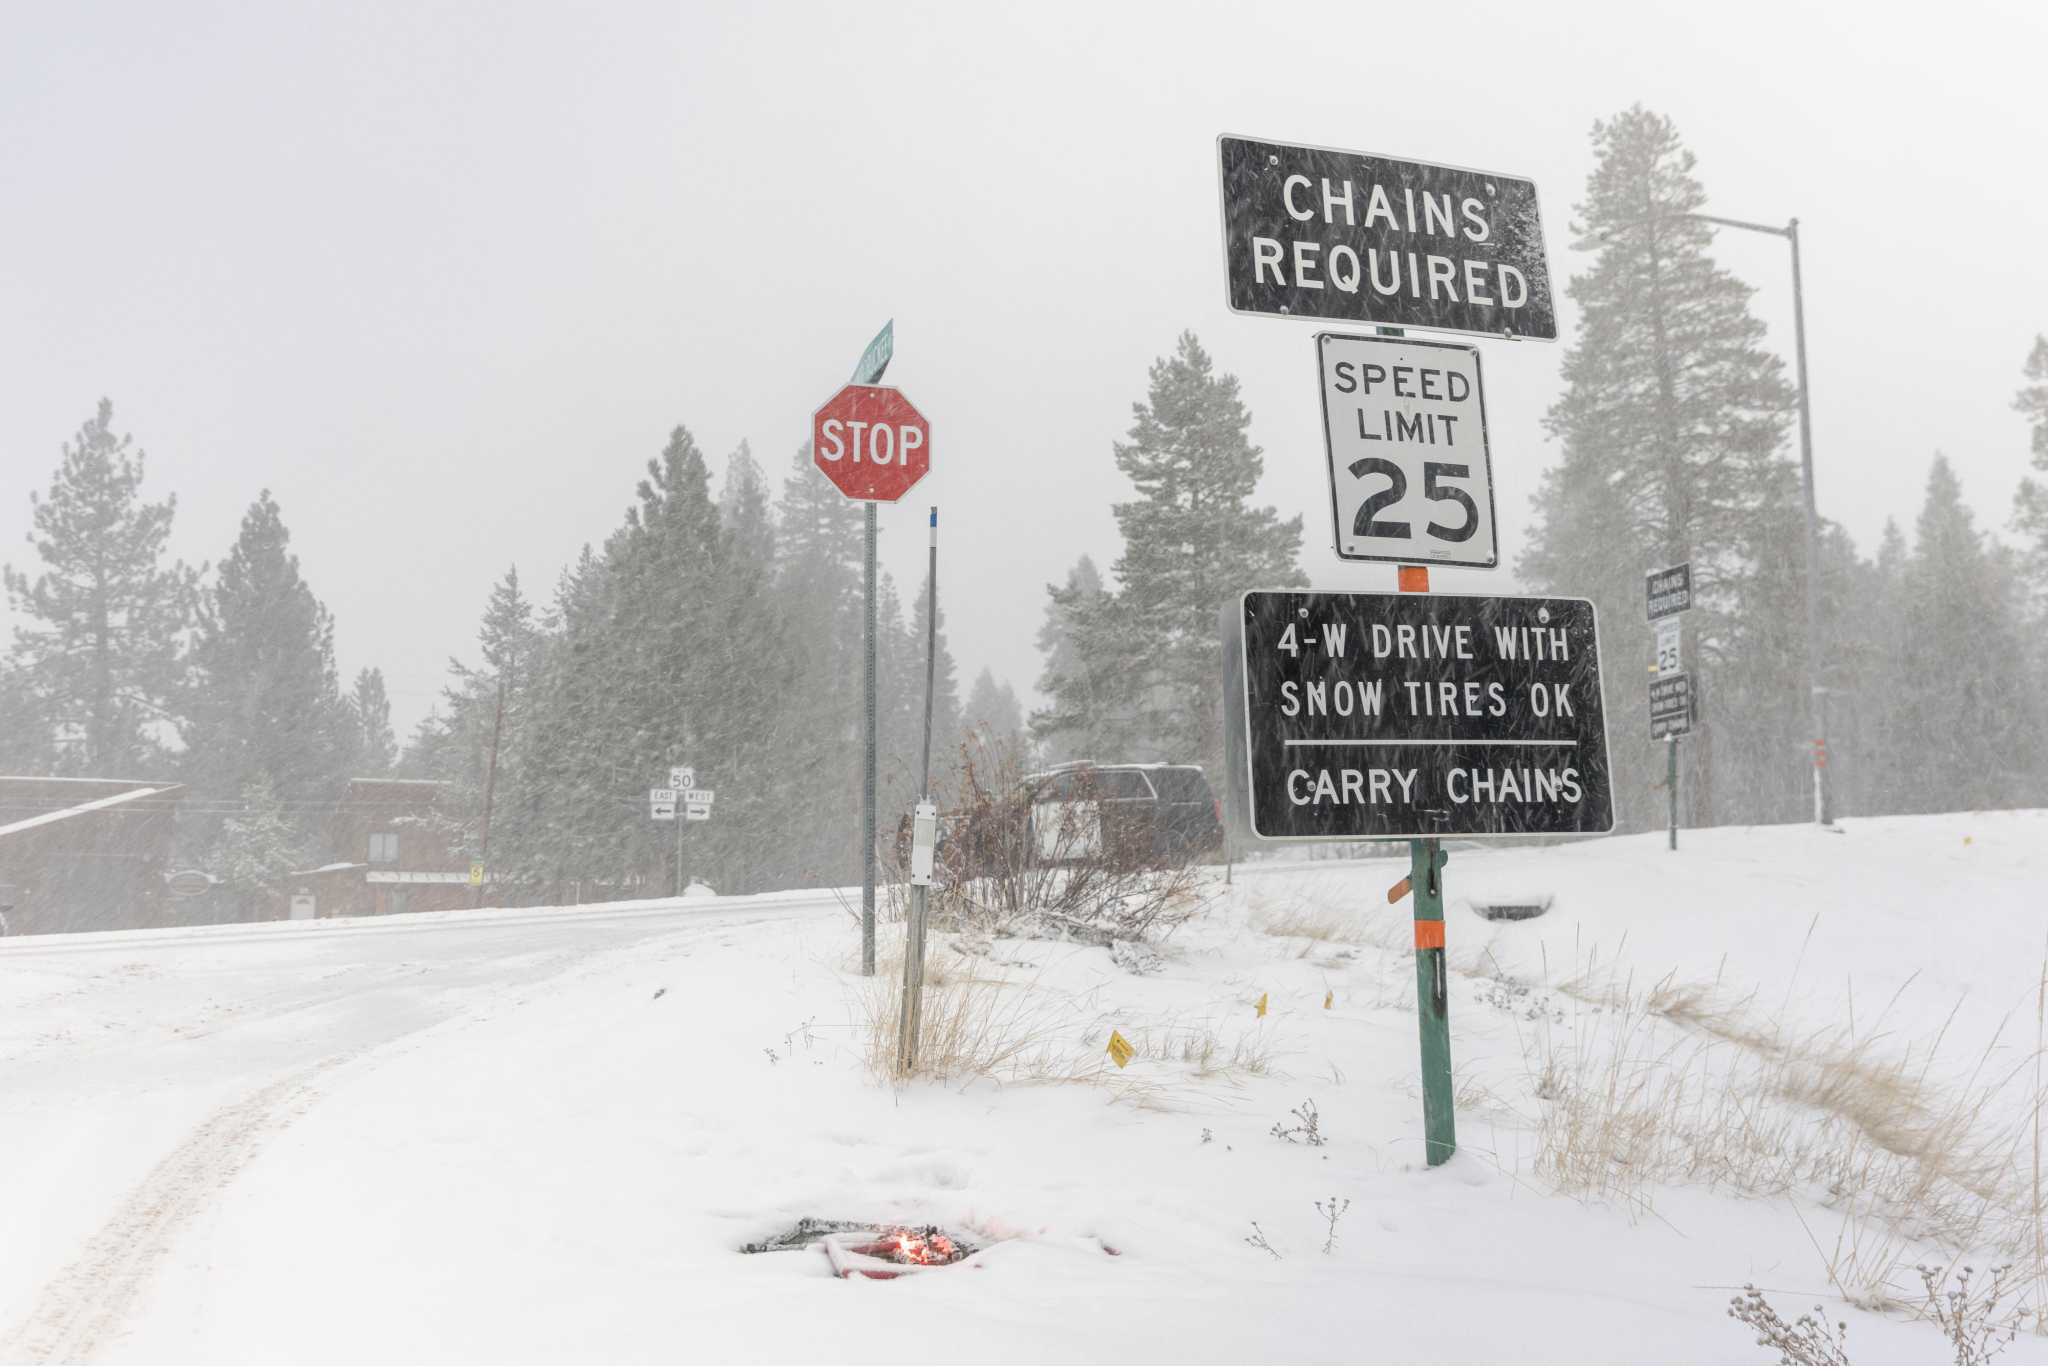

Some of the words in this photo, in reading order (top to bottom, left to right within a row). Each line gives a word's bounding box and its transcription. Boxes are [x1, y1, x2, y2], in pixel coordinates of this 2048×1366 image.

[1283, 174, 1490, 243] CHAINS
[1252, 236, 1528, 309] REQUIRED
[1334, 361, 1470, 403] SPEED
[820, 418, 924, 466] STOP
[1357, 407, 1458, 447] LIMIT
[1348, 457, 1479, 543] 25
[1277, 622, 1347, 659] 4-W
[1372, 623, 1474, 660] DRIVE
[1494, 625, 1570, 662] WITH
[1660, 647, 1677, 671] 25
[1280, 679, 1383, 717] SNOW
[1404, 681, 1506, 717] TIRES
[1530, 682, 1574, 718] OK
[672, 774, 691, 788] 50
[1286, 767, 1419, 807] CARRY
[1446, 767, 1583, 804] CHAINS
